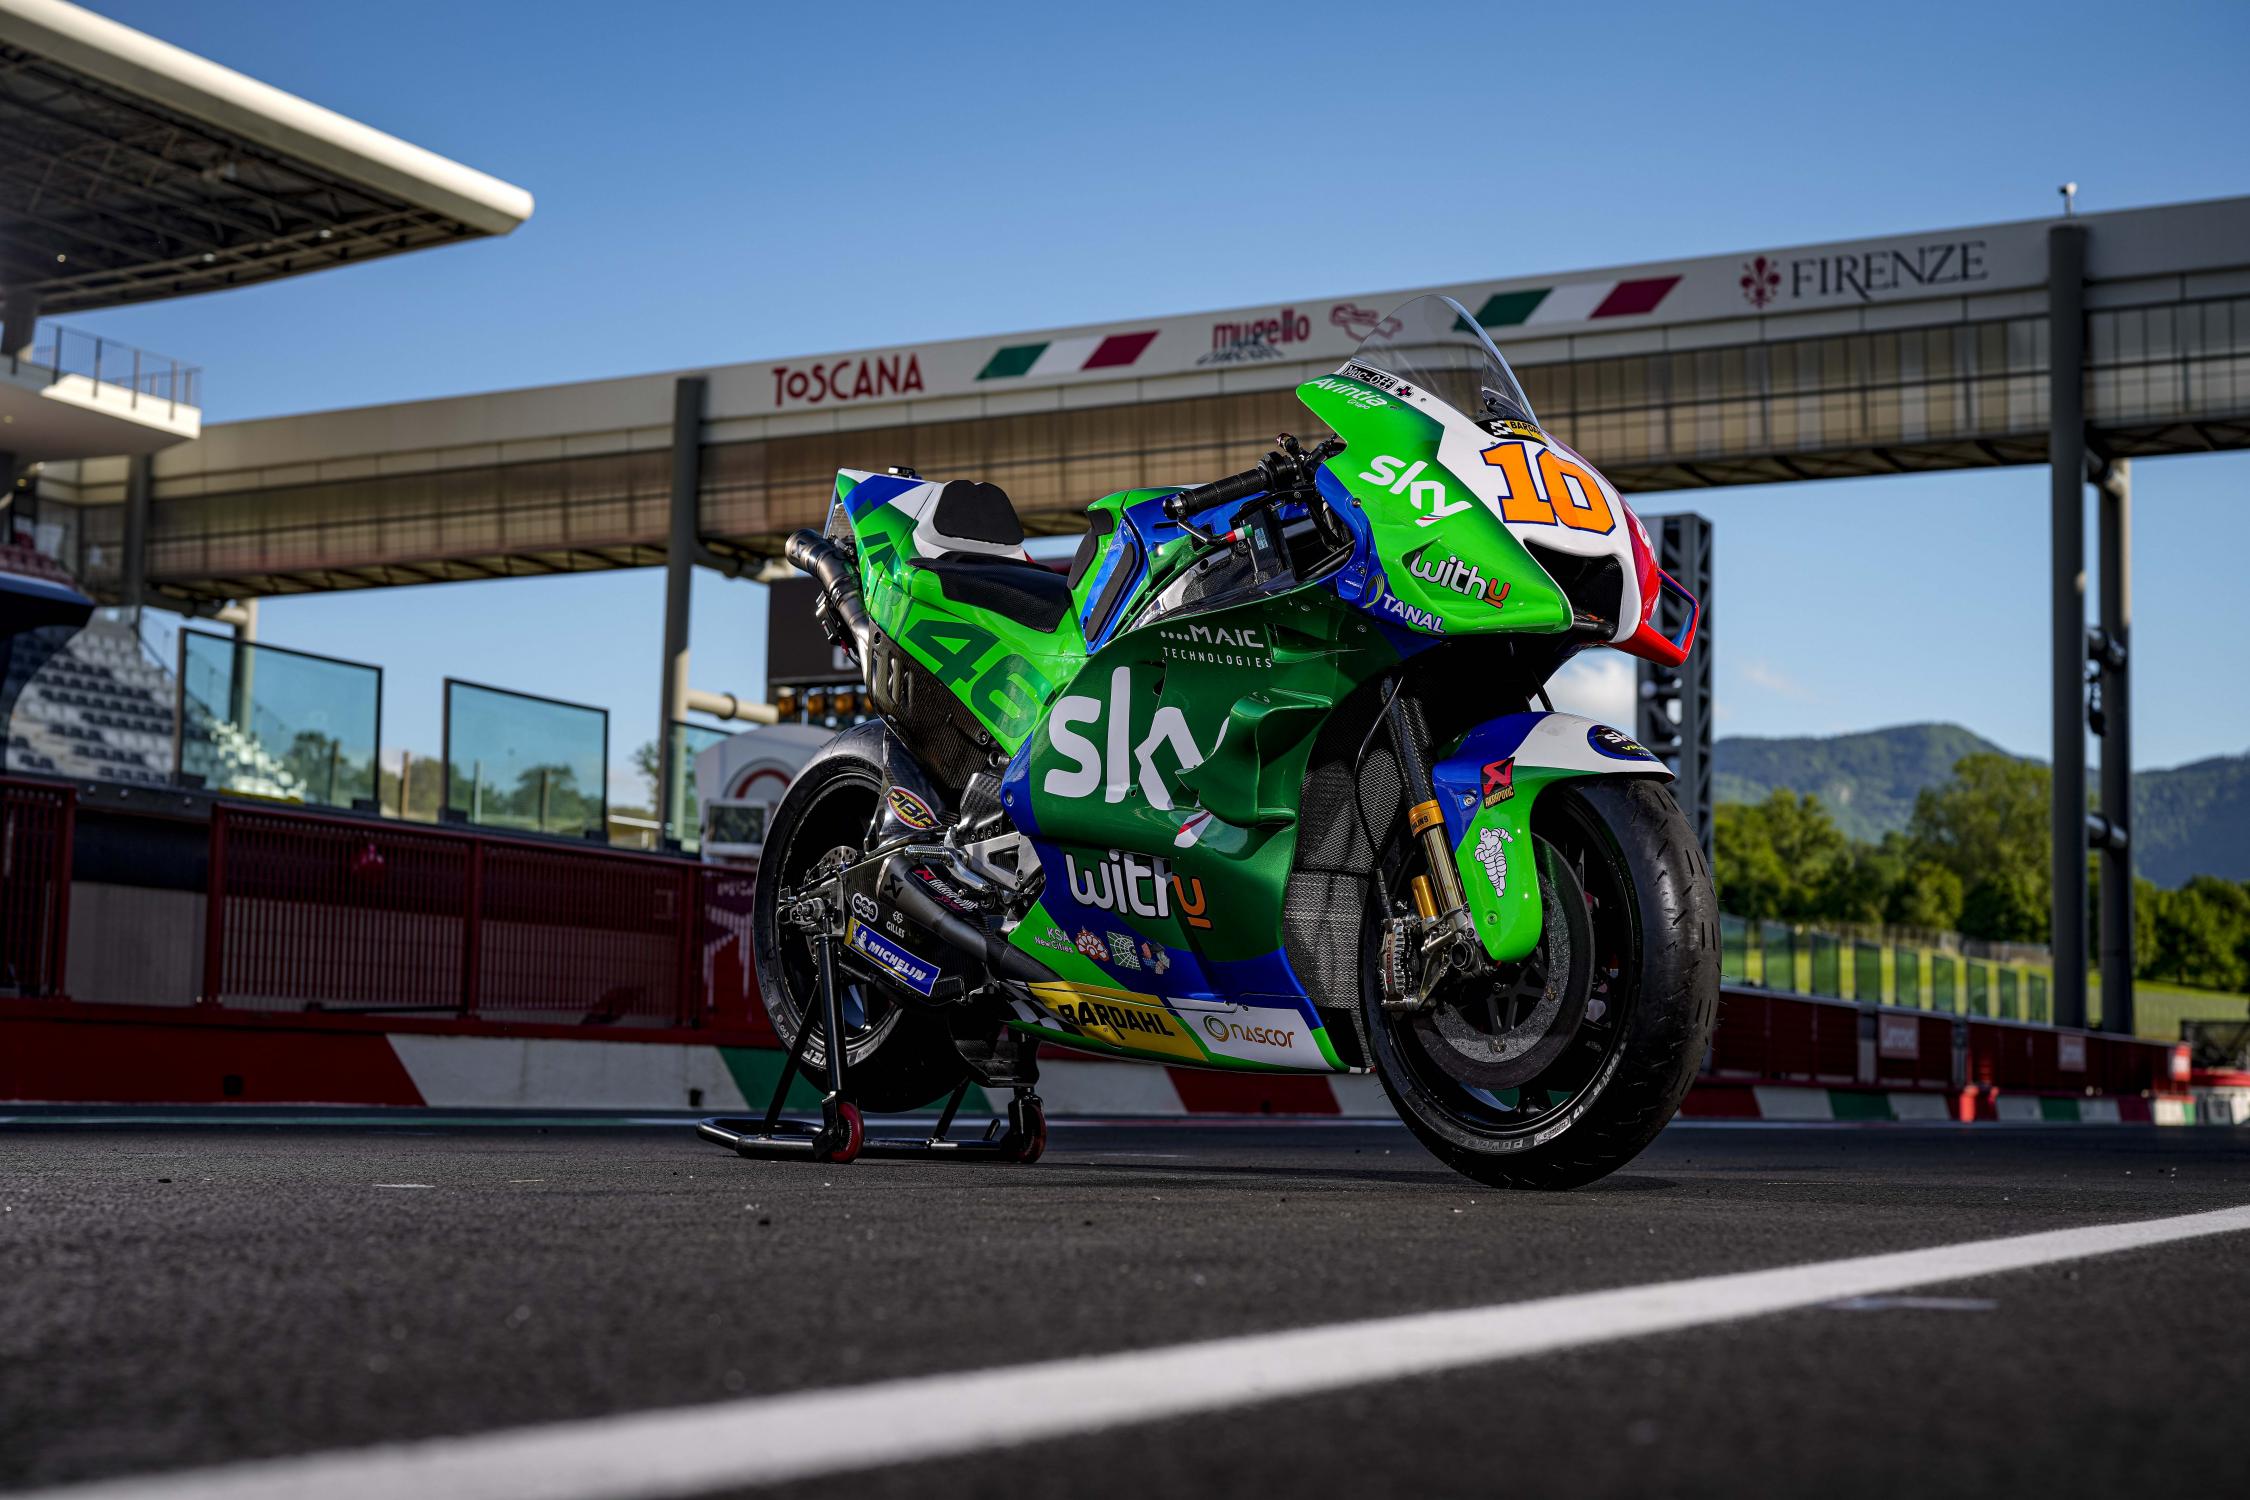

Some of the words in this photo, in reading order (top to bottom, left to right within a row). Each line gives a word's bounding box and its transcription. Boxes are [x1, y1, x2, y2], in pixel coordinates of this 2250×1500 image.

[1790, 240, 1989, 303] FIRENZE
[1212, 307, 1310, 352] mugello
[771, 353, 925, 408] TOSCANA
[1304, 378, 1388, 407] Avintia
[1344, 364, 1394, 391] Muc-Off
[1358, 454, 1472, 528] sky
[1479, 440, 1616, 536] 10
[1383, 592, 1446, 634] TANAL
[1162, 646, 1272, 668] TECHNOLOGIES
[904, 618, 1038, 739] 46
[886, 920, 905, 939] GILLES
[1047, 925, 1072, 944] KSA
[867, 941, 927, 981] MICHELIN
[1057, 1001, 1175, 1040] BARDAHL
